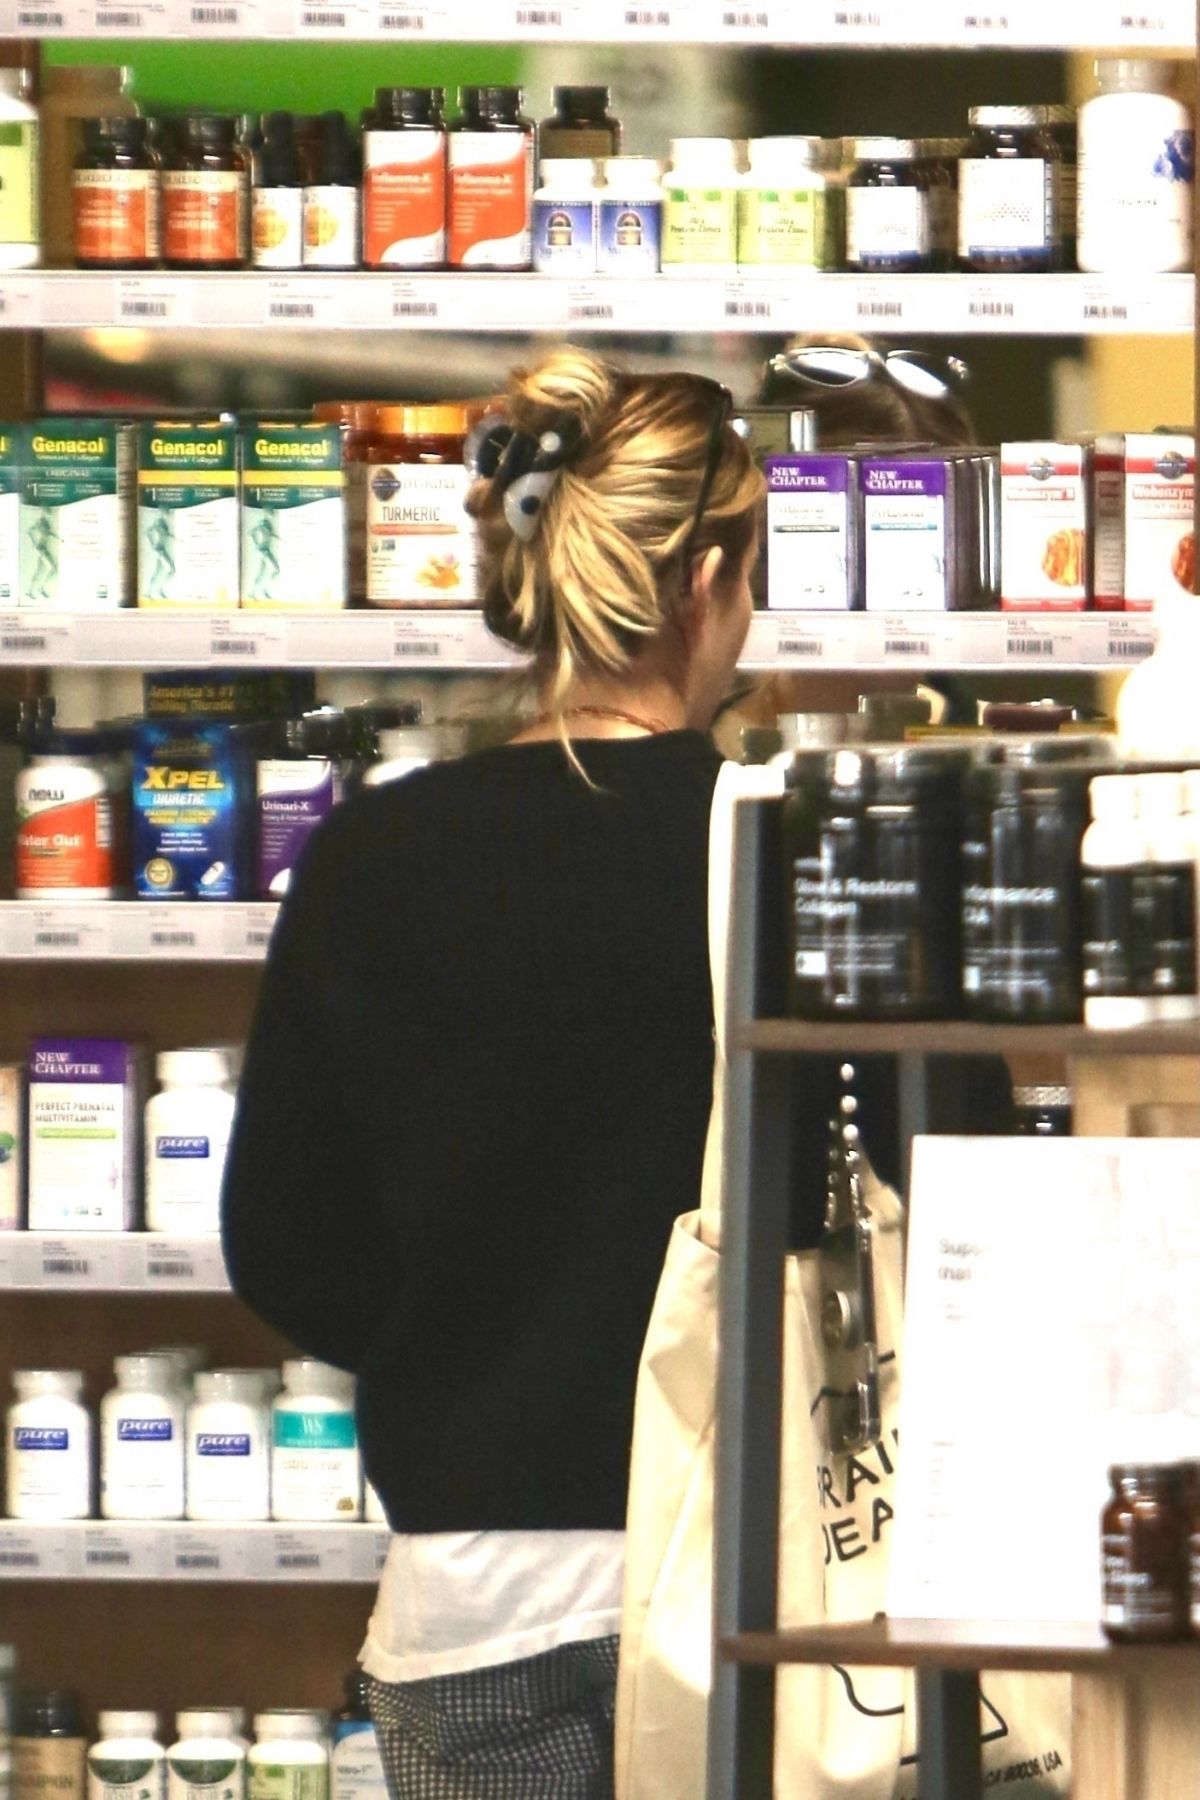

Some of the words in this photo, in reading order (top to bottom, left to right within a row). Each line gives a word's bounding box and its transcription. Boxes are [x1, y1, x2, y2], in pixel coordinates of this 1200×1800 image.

[32, 436, 105, 453] Genacol
[151, 439, 223, 456] Genacol
[255, 439, 329, 457] Genacol
[772, 467, 800, 476] NEW
[869, 470, 898, 480] NEW
[771, 475, 826, 486] CHAPTER
[868, 479, 923, 490] CHAPTER
[382, 506, 440, 521] TURMERIC
[141, 766, 224, 790] XPEL
[152, 793, 205, 805] DIURETIC
[262, 801, 309, 811] Urinari-X
[35, 1052, 69, 1063] NEW
[34, 1063, 101, 1075] CHAPTER
[158, 1137, 206, 1150] pure
[121, 1421, 169, 1433] pure
[17, 1430, 65, 1441] pure
[199, 1436, 246, 1447] pure
